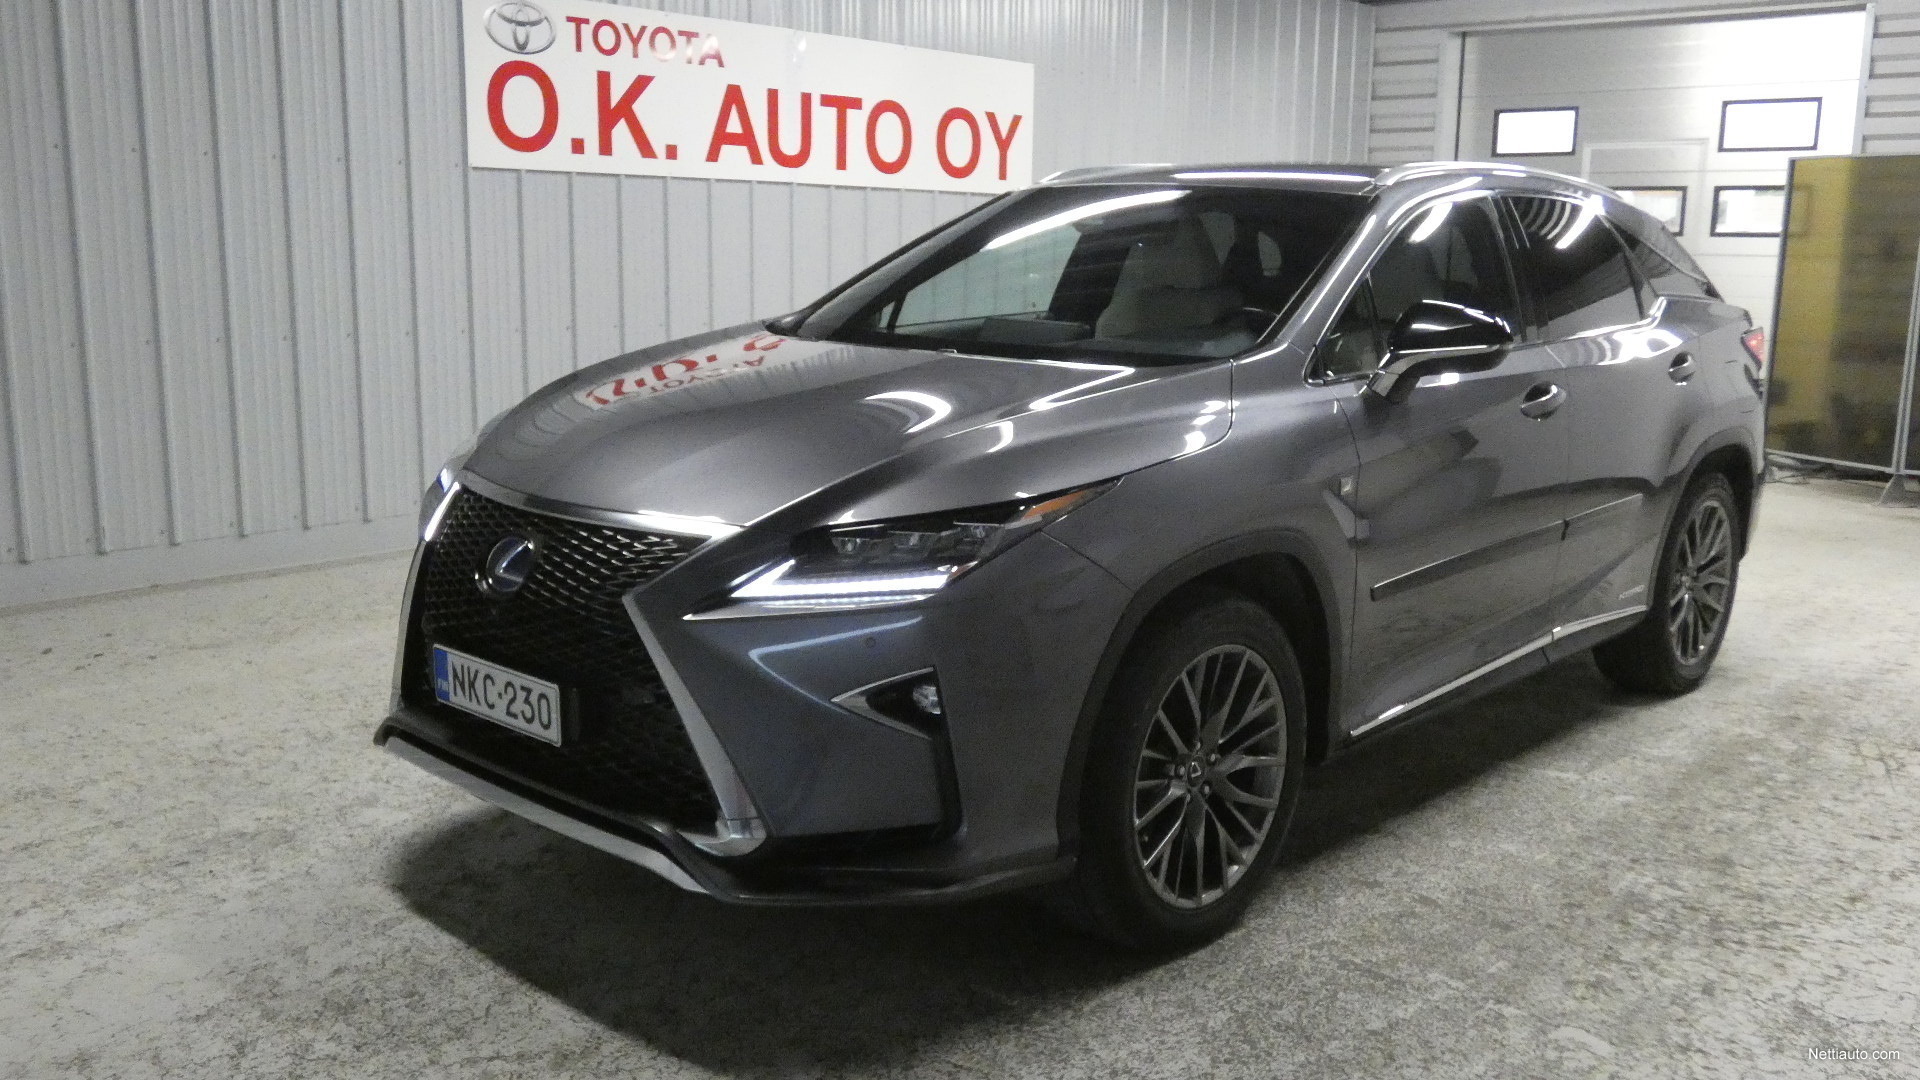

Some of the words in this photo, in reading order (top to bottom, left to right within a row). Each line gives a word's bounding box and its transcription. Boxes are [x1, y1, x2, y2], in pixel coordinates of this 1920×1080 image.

[566, 16, 725, 68] TOYOTA
[487, 60, 678, 160] O.K.
[705, 83, 912, 174] AUTO
[936, 107, 1022, 181] OY
